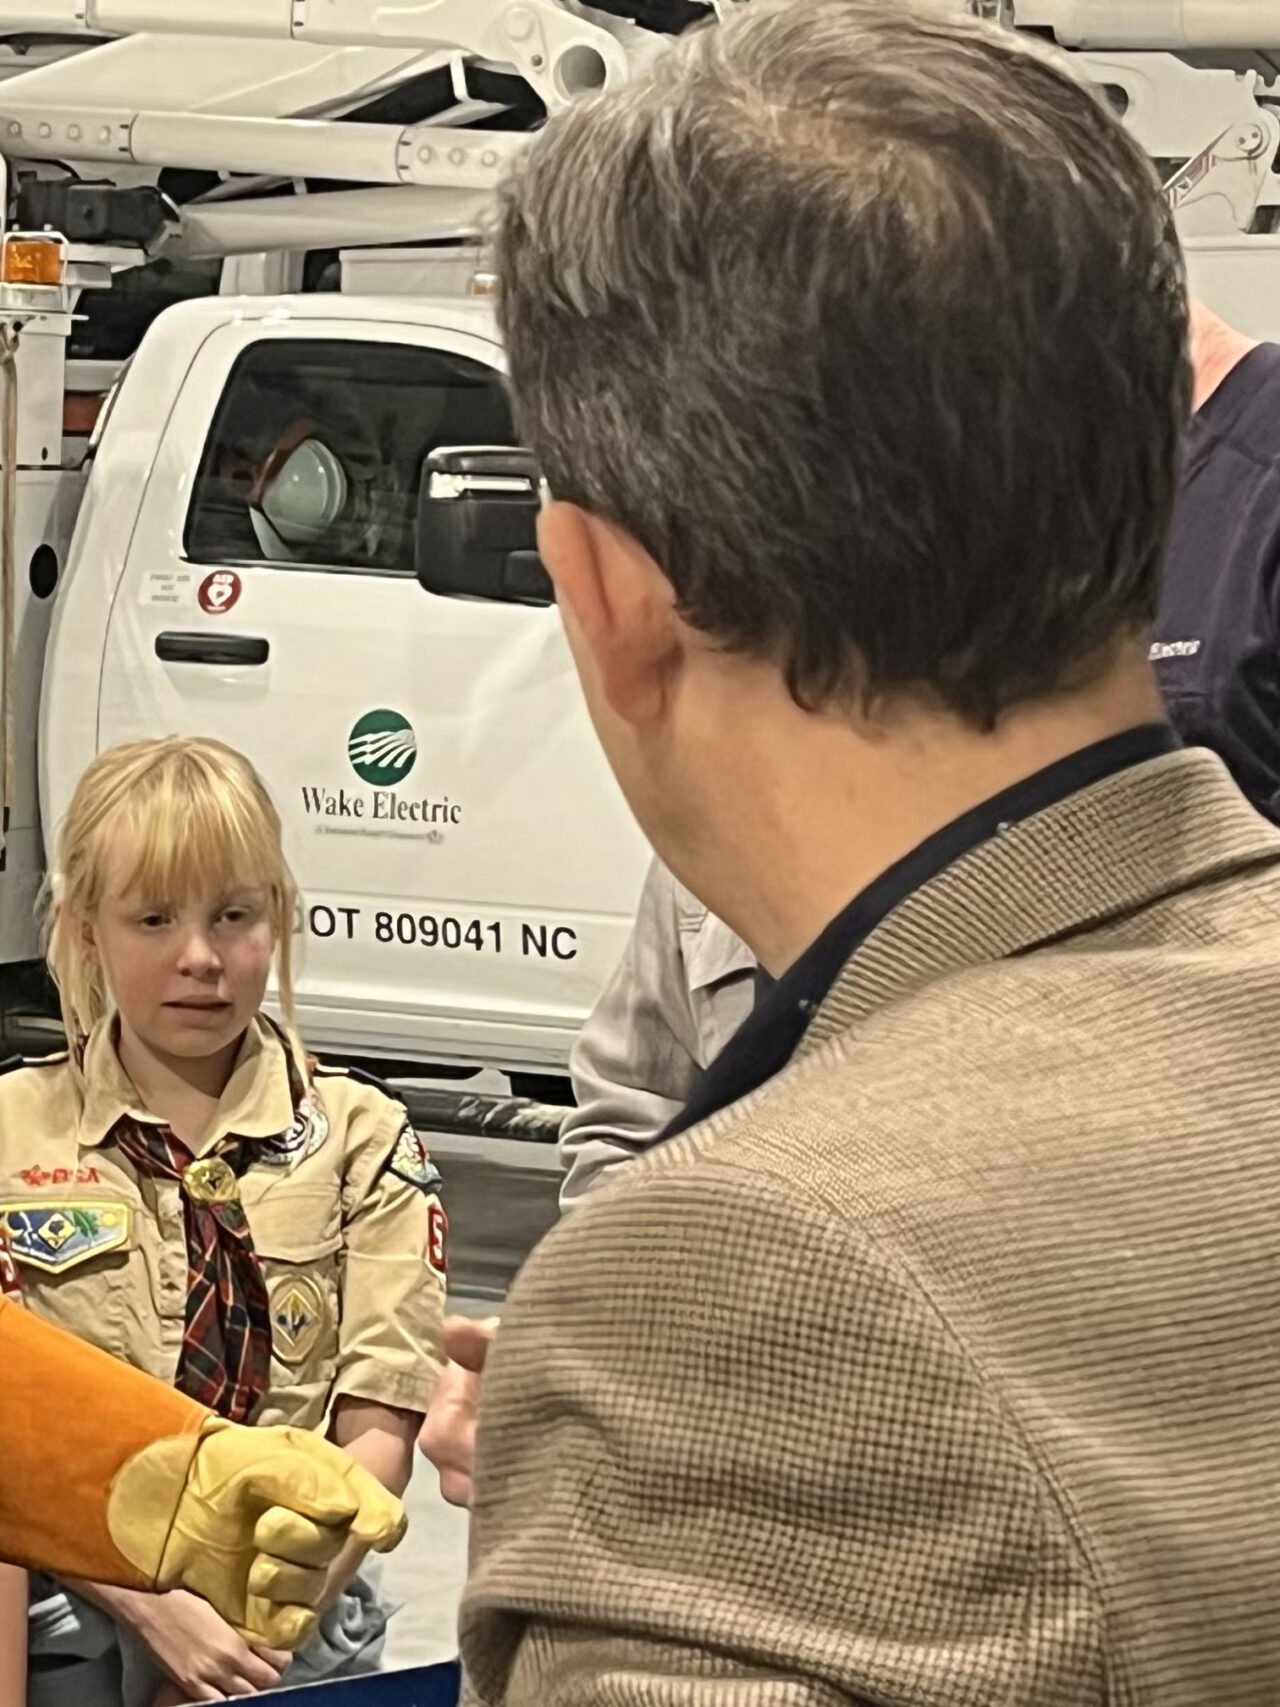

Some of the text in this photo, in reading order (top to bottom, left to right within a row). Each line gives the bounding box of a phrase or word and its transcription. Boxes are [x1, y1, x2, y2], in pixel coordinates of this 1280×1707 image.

[301, 786, 462, 825] Wake Electric
[292, 904, 578, 960] OT 809041 NC
